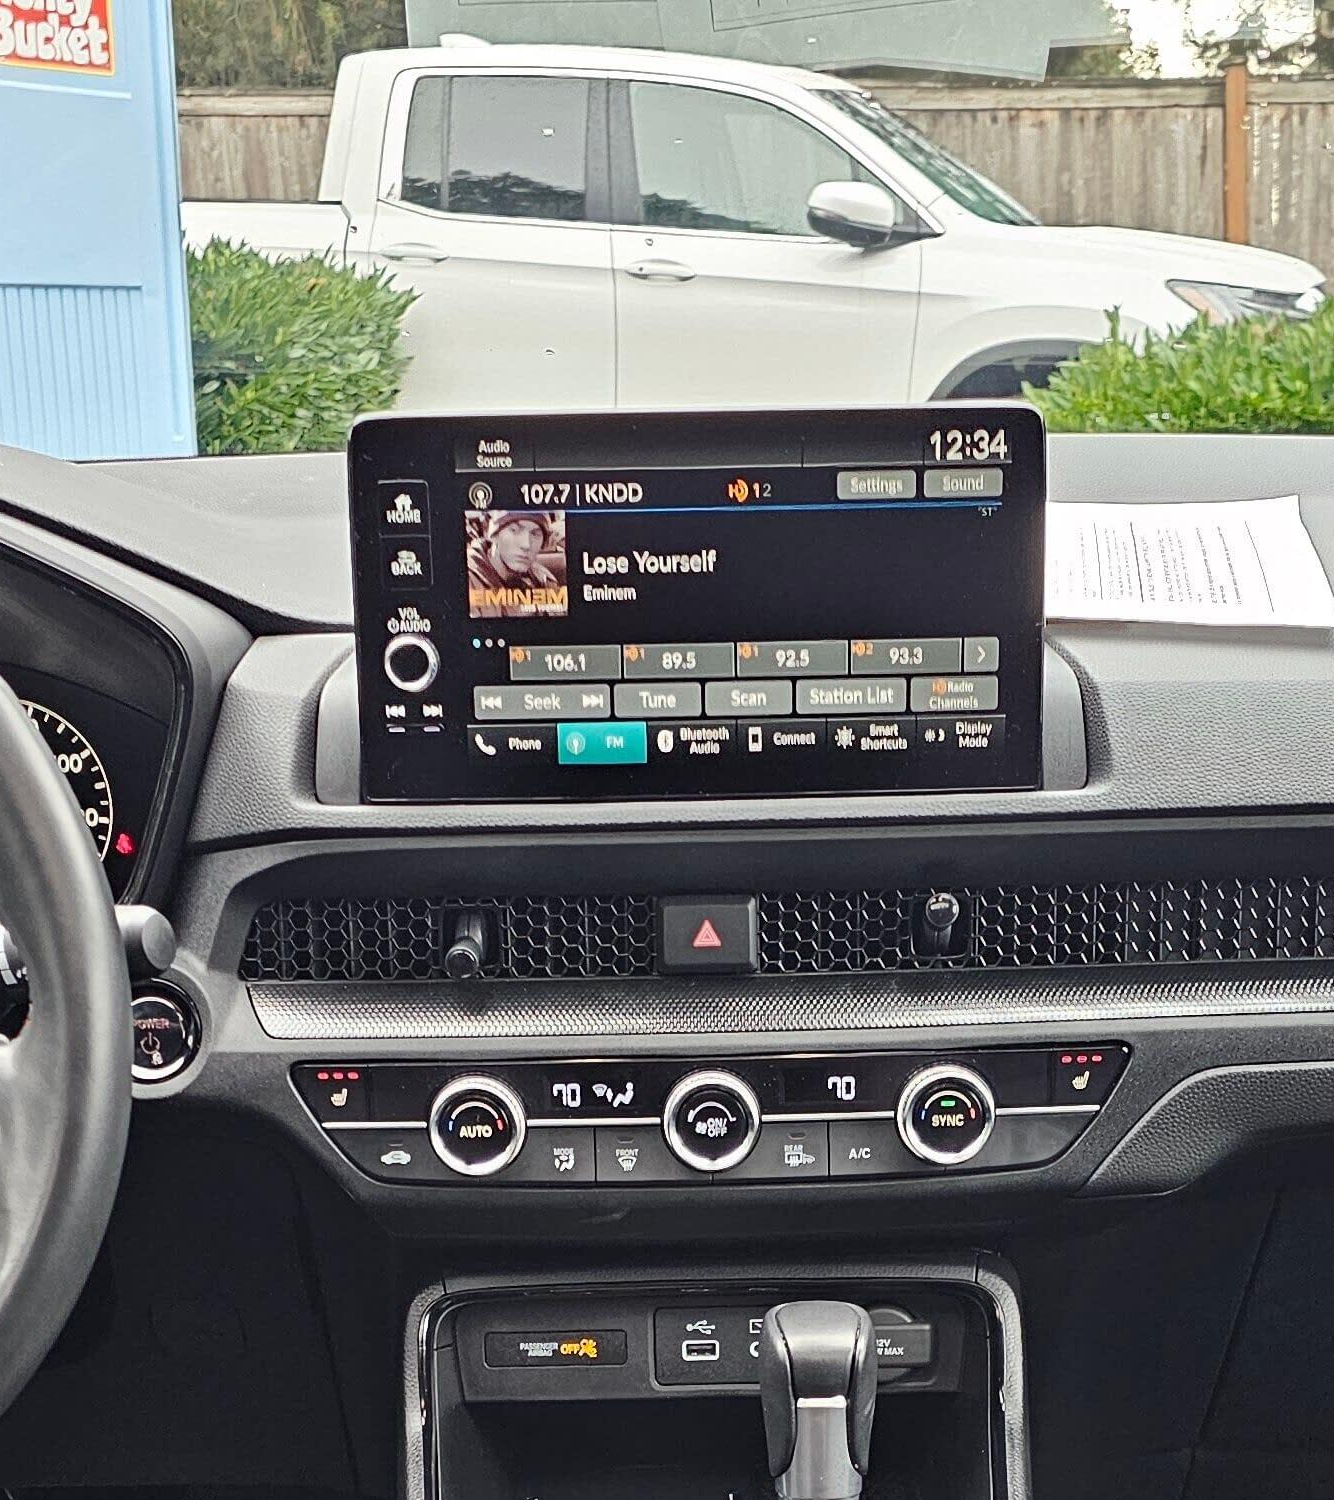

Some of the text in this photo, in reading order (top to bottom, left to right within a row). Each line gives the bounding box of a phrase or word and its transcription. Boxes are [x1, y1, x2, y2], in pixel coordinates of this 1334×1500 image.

[479, 440, 509, 453] Audio
[930, 429, 1007, 461] 12:34
[476, 455, 512, 467] Source
[850, 477, 902, 495] Settings
[943, 475, 984, 492] Sound
[521, 482, 642, 504] 107.7 KNDD
[386, 509, 421, 523] HOME
[391, 562, 422, 575] BACK
[583, 550, 716, 574] Lose Yourself
[583, 584, 636, 602] Eminem
[398, 608, 419, 620] VOL
[400, 619, 431, 632] AUDIO
[545, 654, 586, 672] 106.1
[662, 652, 696, 670] 89.5
[776, 649, 810, 668] 92.5
[889, 647, 923, 665] 93.3
[948, 681, 973, 693] Radio
[524, 694, 561, 710] Seek
[639, 691, 676, 708] Tune
[730, 689, 766, 707] Scan
[810, 686, 894, 705] Station List
[929, 697, 978, 710] Channels
[679, 726, 729, 741] Bluetooth
[870, 724, 899, 737] Smart
[955, 721, 992, 736] Display
[509, 737, 541, 750] Phone
[606, 736, 624, 748] FM
[773, 732, 816, 746] Connect
[861, 737, 907, 751] Shortcuts
[958, 735, 988, 748] Mode
[689, 741, 720, 755] Audio
[53, 754, 83, 773] 00
[553, 1083, 581, 1107] 70
[827, 1076, 855, 1100] 70
[931, 1114, 964, 1127] SYNC
[460, 1126, 492, 1139] AUTO
[707, 1127, 728, 1137] OFF
[849, 1148, 870, 1160] A/C
[560, 1344, 580, 1354] OFF
[884, 1347, 904, 1355] MAX
